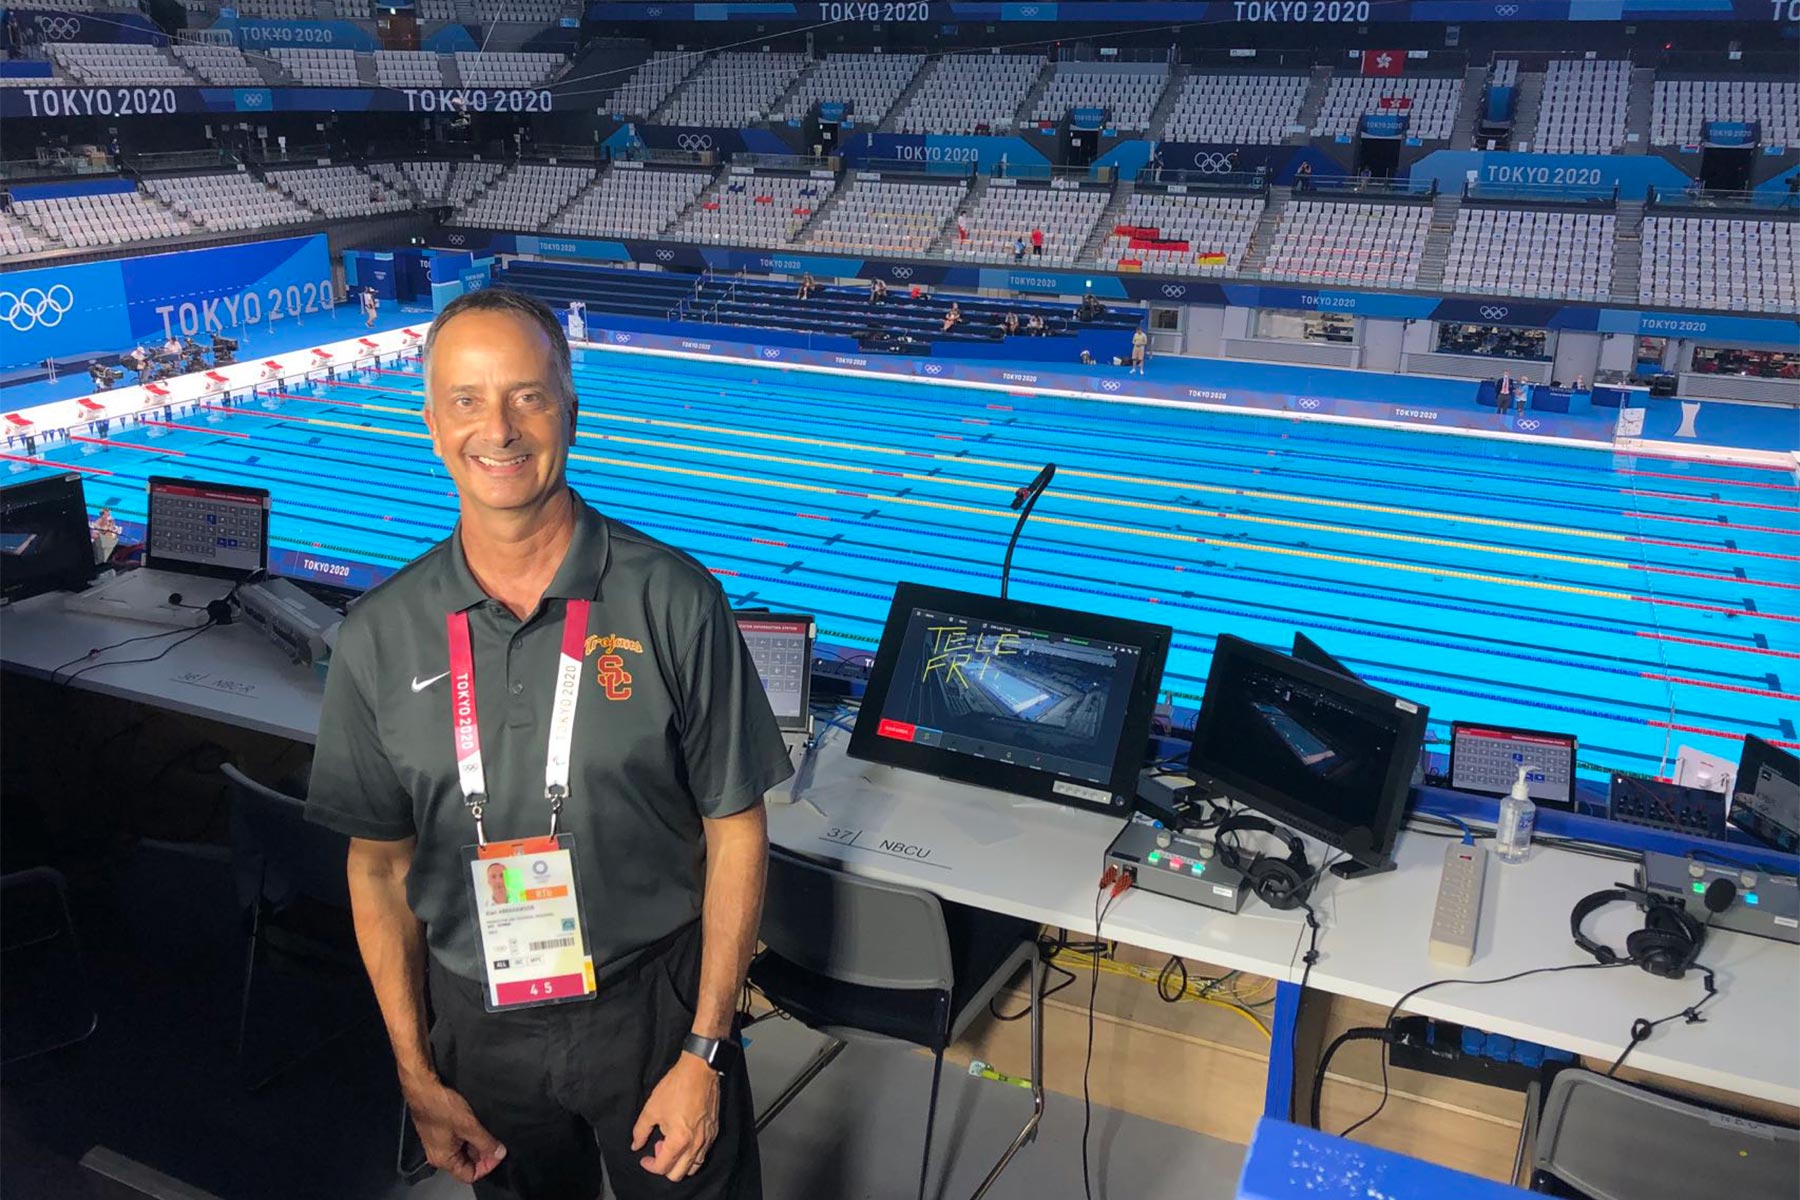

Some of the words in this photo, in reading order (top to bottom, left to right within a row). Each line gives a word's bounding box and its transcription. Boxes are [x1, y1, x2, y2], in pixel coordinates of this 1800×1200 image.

[819, 3, 879, 21] TOKYO
[884, 3, 929, 21] 2020
[1234, 1, 1307, 22] TOKYO
[1312, 1, 1370, 22] 2020
[240, 27, 292, 42] TOKYO
[296, 28, 333, 43] 2020
[24, 89, 112, 117] TOKYO
[116, 88, 177, 115] 2020
[403, 90, 487, 112] TOKYO
[494, 90, 553, 112] 2020
[895, 145, 941, 161] TOKYO
[944, 148, 979, 162] 2020
[1488, 165, 1548, 183] TOKYO
[1554, 167, 1601, 185] 2020
[540, 242, 559, 251] TOKYO
[760, 258, 783, 267] TOKYO
[784, 260, 801, 269] 2020
[1010, 276, 1035, 286] TOKYO
[1036, 278, 1056, 287] 2020
[155, 292, 261, 339] TOKYO
[268, 279, 334, 321] 2020
[1300, 295, 1331, 306] TOKYO
[1332, 297, 1356, 308] 2020
[1641, 319, 1677, 331] TOKYO
[1679, 321, 1707, 332] 2020
[835, 356, 852, 364] TOKYO
[853, 358, 867, 366] 2020
[1002, 373, 1021, 382] TOKYO
[1022, 374, 1037, 383] 2020
[1188, 389, 1210, 398] TOKYO
[1211, 391, 1227, 400] 2020
[1395, 408, 1419, 418] TOKYO
[1419, 410, 1438, 420] 2020
[304, 559, 329, 573] TOKYO
[329, 564, 350, 577] 2020
[584, 633, 643, 656] Trojans
[928, 626, 1021, 656] TELE
[562, 665, 577, 696] 2020
[597, 654, 632, 700] SC
[456, 672, 471, 716] TOKYO
[459, 717, 474, 750] 2020
[879, 839, 931, 859] NBCU
